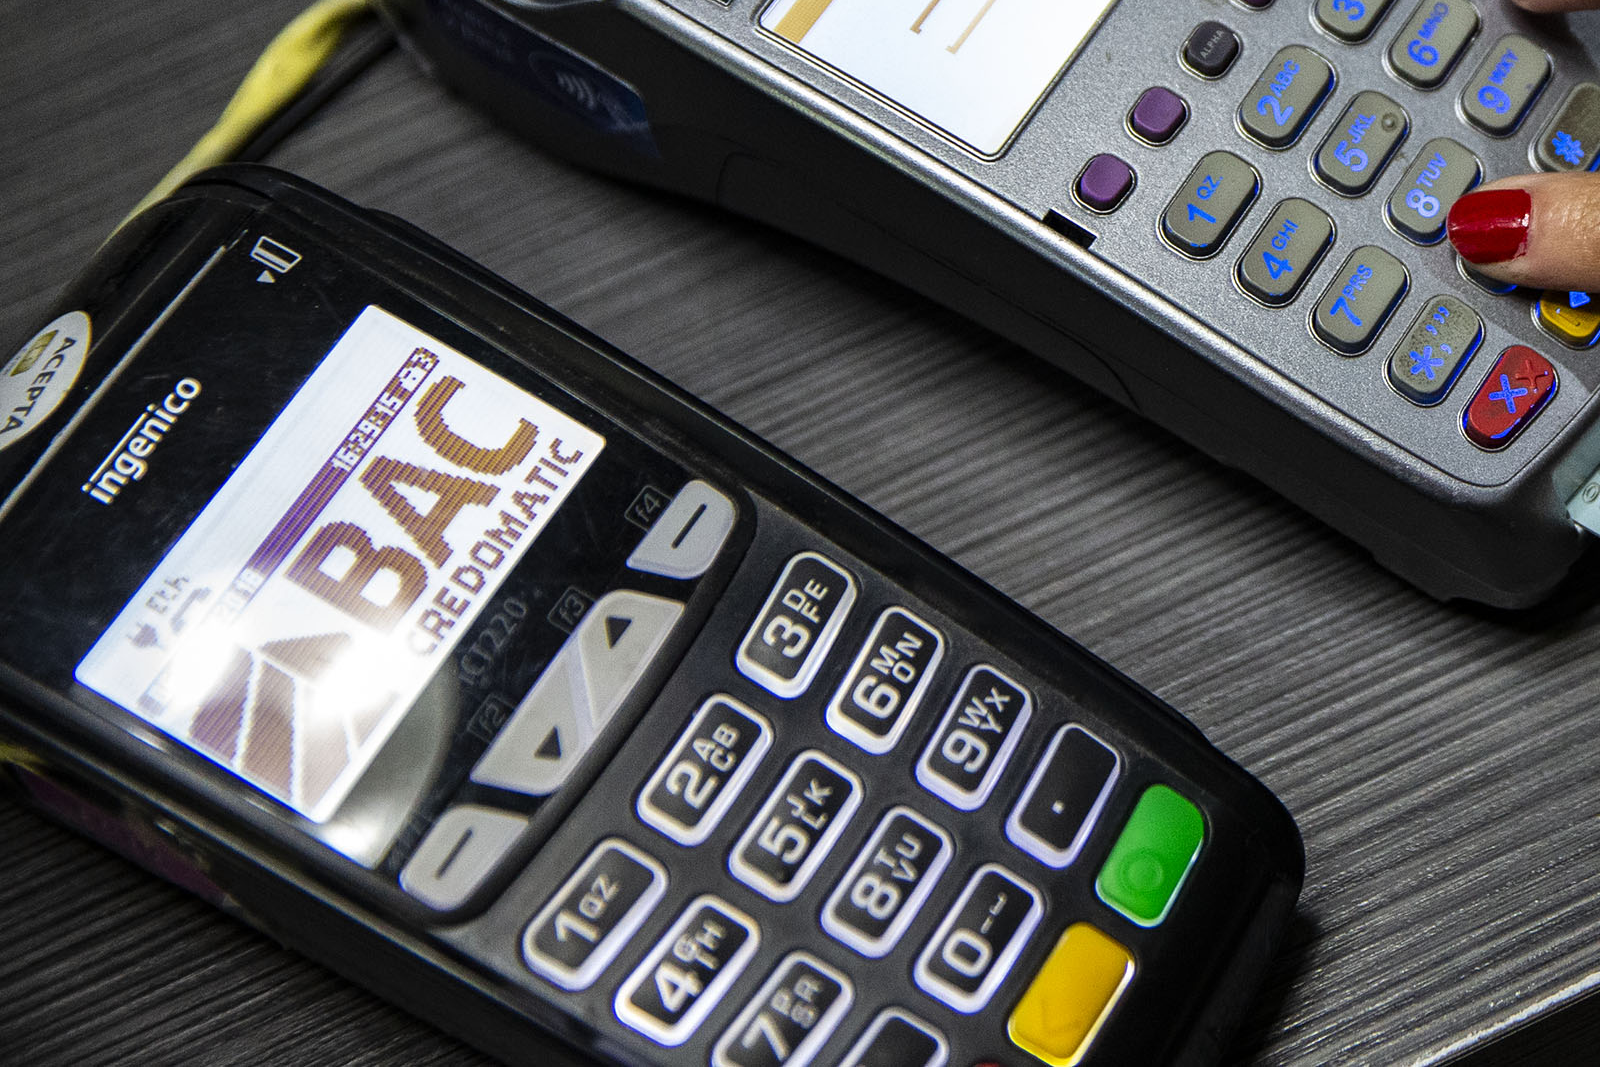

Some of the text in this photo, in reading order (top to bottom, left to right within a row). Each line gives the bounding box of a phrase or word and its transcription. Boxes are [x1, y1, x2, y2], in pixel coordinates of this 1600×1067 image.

[1199, 28, 1225, 61] ALPHA
[0, 336, 77, 433] ACEPTA
[80, 376, 202, 506] ingenico
[282, 374, 541, 632] BAC
[406, 438, 584, 656] CREDOMATIC
